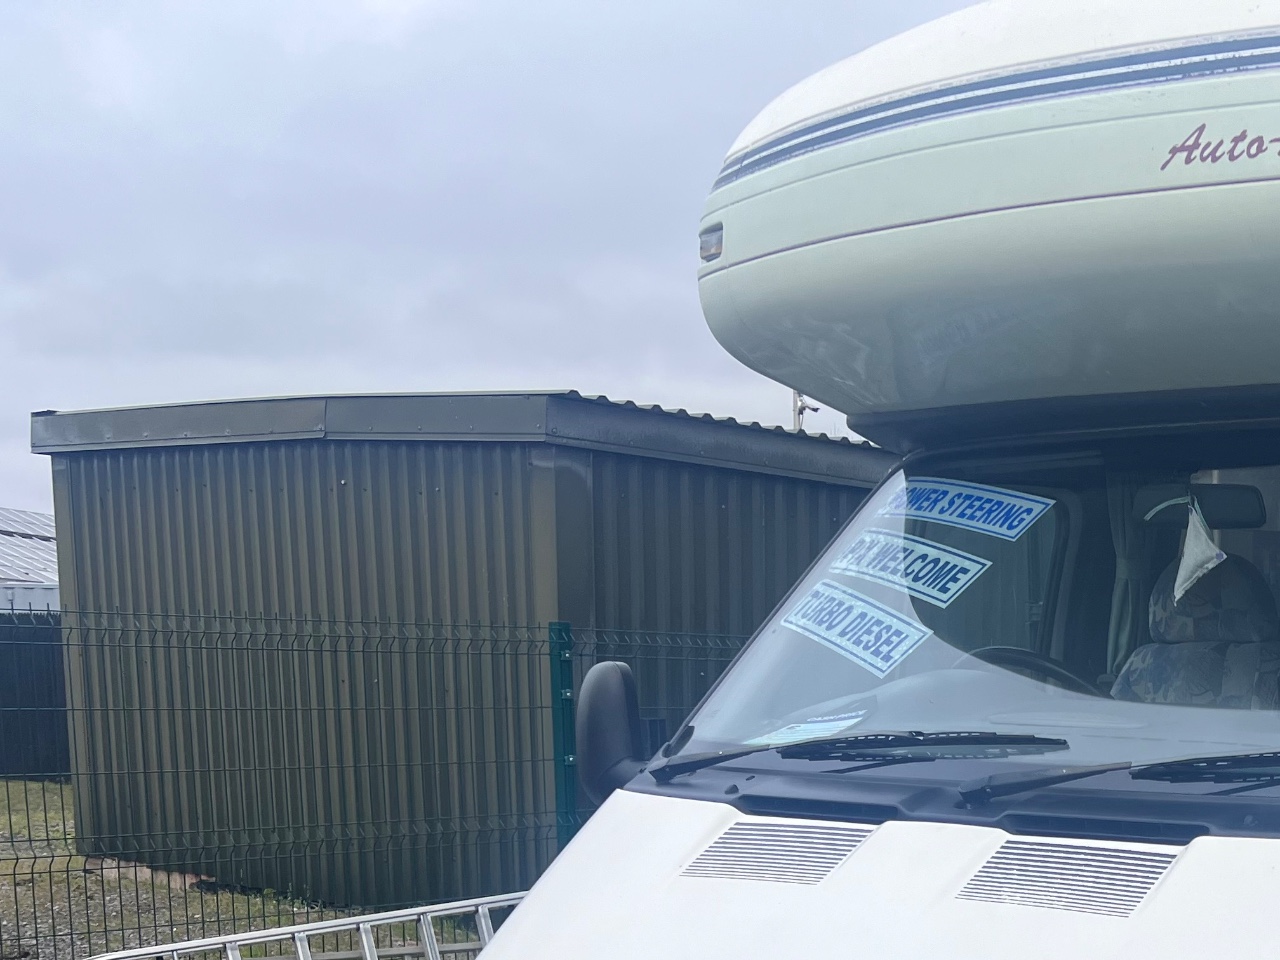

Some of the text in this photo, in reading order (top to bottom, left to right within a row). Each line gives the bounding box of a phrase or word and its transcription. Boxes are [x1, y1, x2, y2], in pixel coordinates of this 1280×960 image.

[941, 492, 1034, 531] STEERING
[865, 542, 971, 596] WELCOME
[794, 590, 910, 664] TURBO DIESEL
